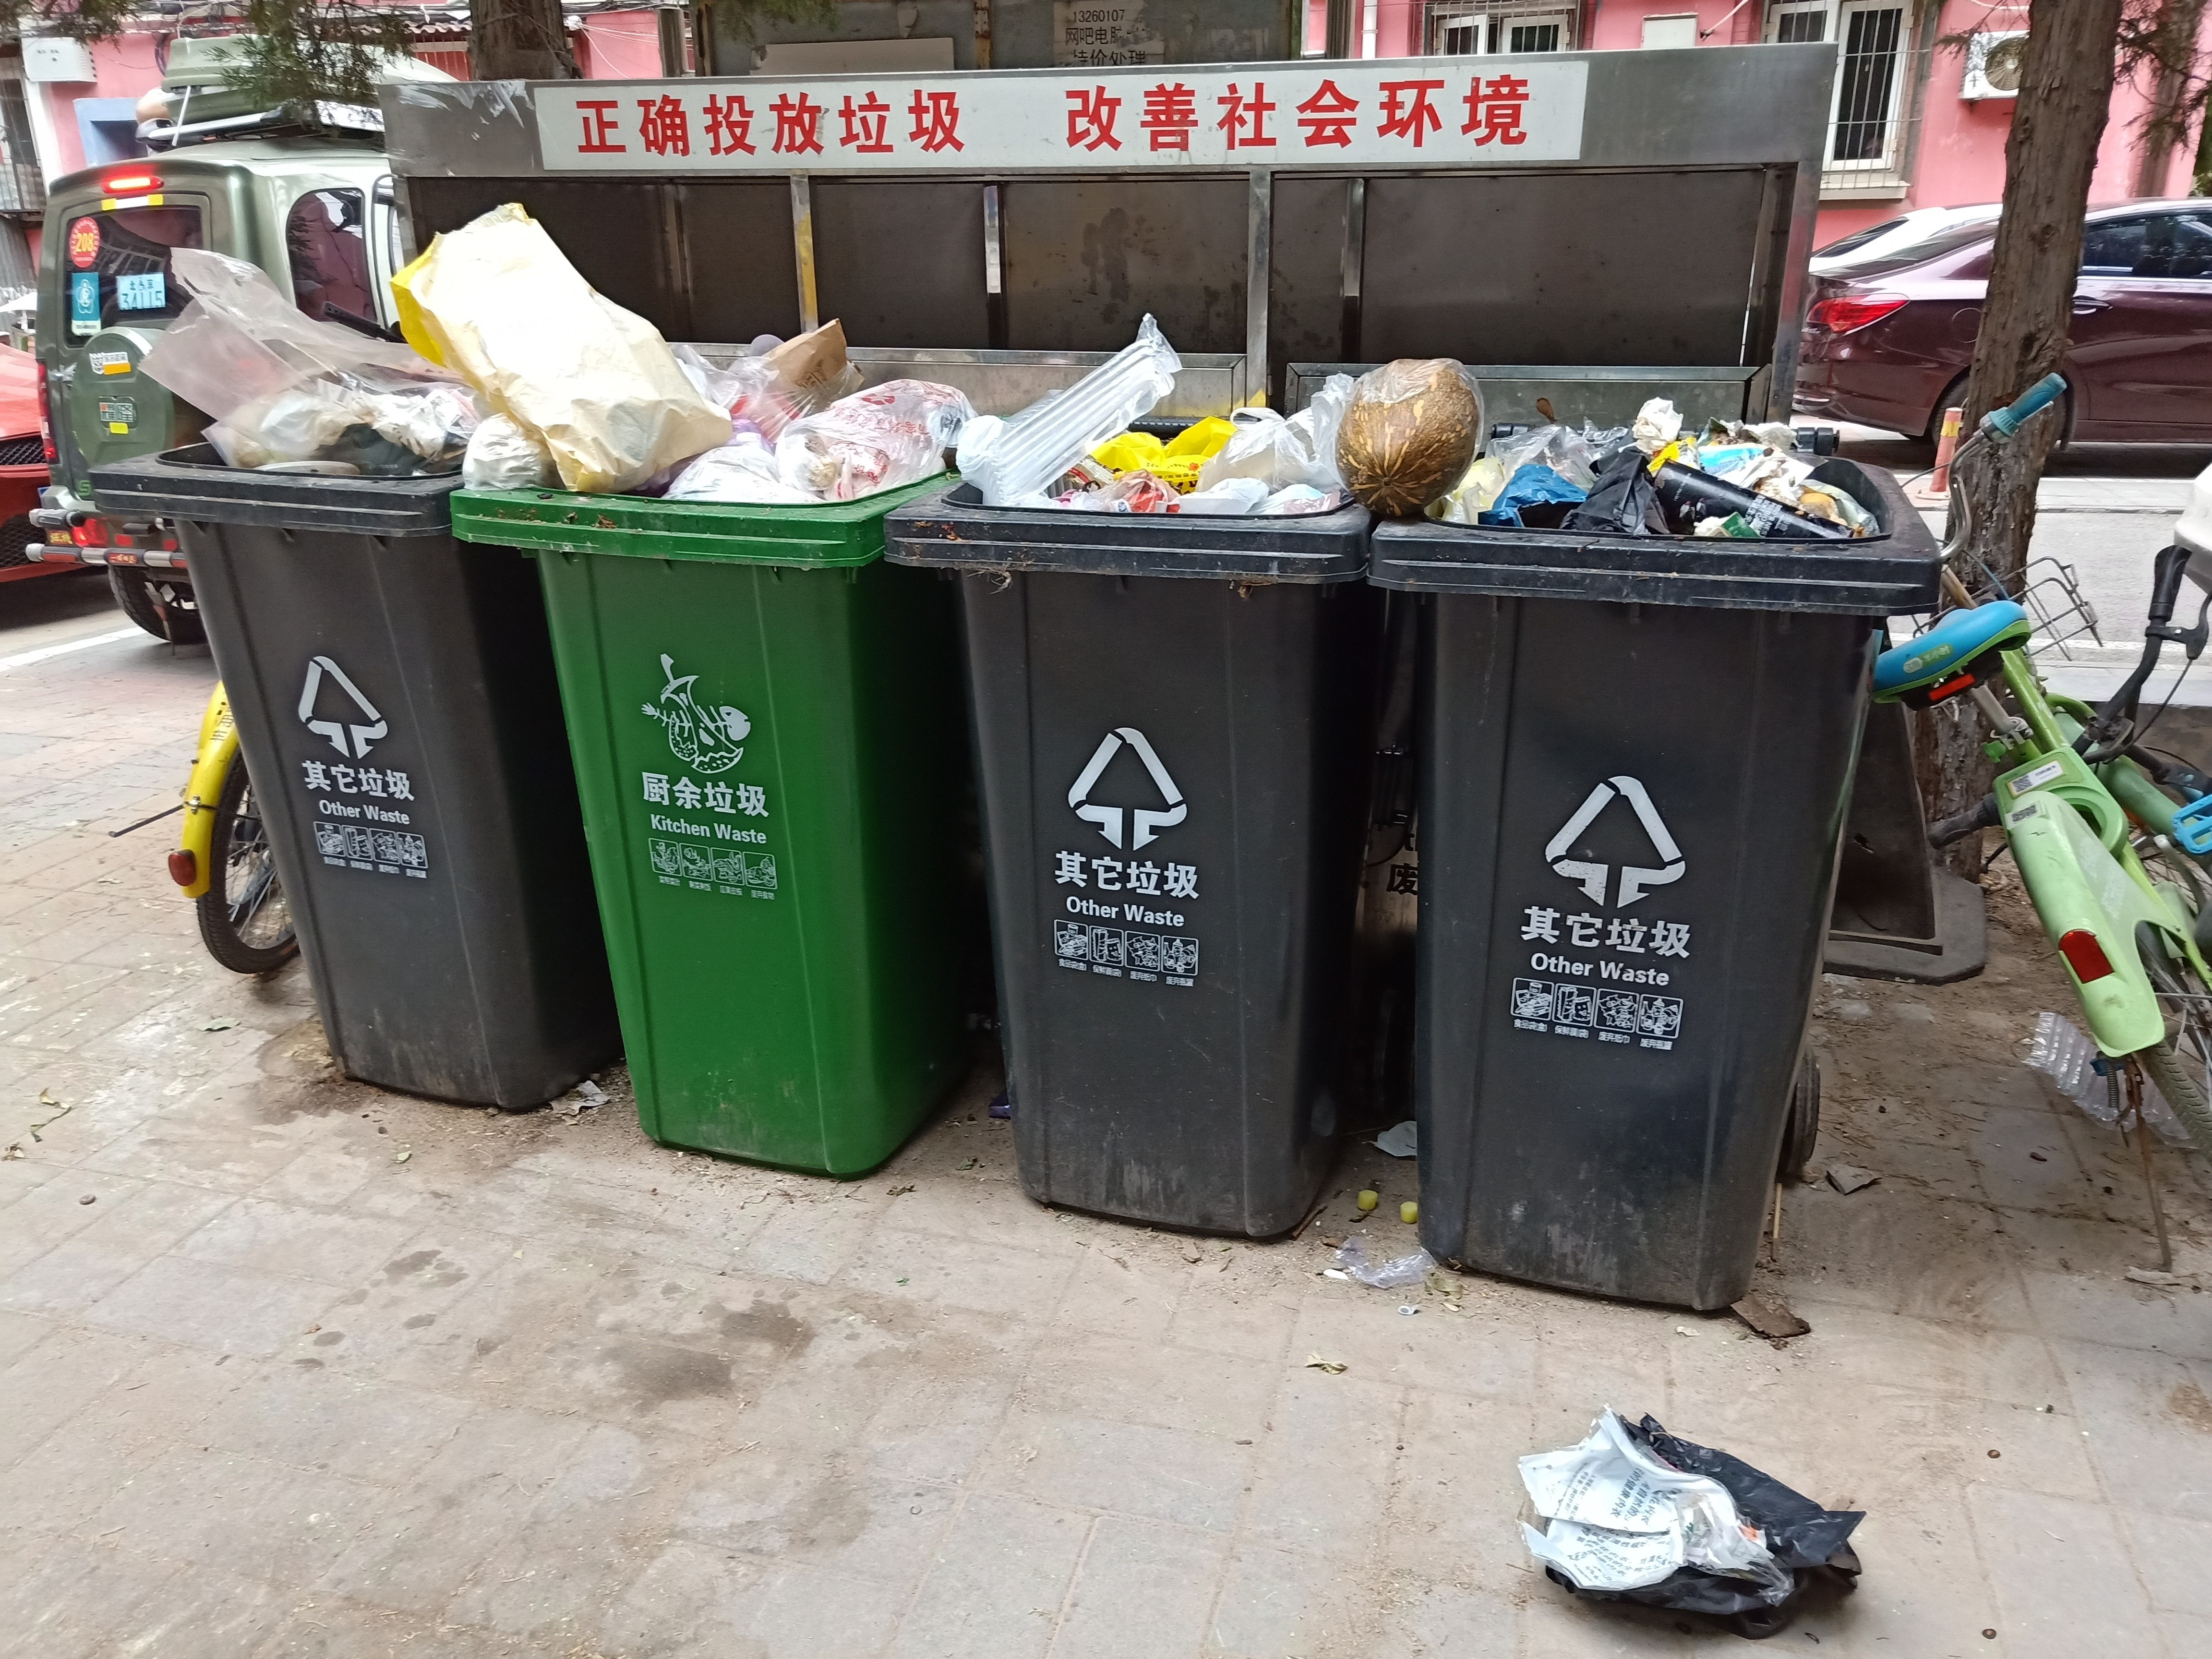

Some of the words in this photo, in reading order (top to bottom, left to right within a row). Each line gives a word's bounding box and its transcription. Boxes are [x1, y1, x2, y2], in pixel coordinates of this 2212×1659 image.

[1073, 9, 1125, 23] 13260107
[576, 89, 965, 156] 正确投放垃圾
[1066, 74, 1530, 152] 改善社会环境
[75, 232, 95, 252] 208
[302, 760, 415, 801] 其它垃圾
[642, 772, 769, 817] 厨余垃圾
[319, 800, 361, 818] Other
[363, 805, 410, 825] Waste
[650, 814, 710, 837] Kitchen
[713, 823, 767, 844] Waste
[1055, 851, 1199, 899] 其它垃圾
[1066, 896, 1119, 919] Other
[1123, 904, 1184, 926] Waste
[1521, 906, 1690, 958] 其它垃圾
[1531, 953, 1594, 976] Other
[1600, 961, 1669, 986] Waste
